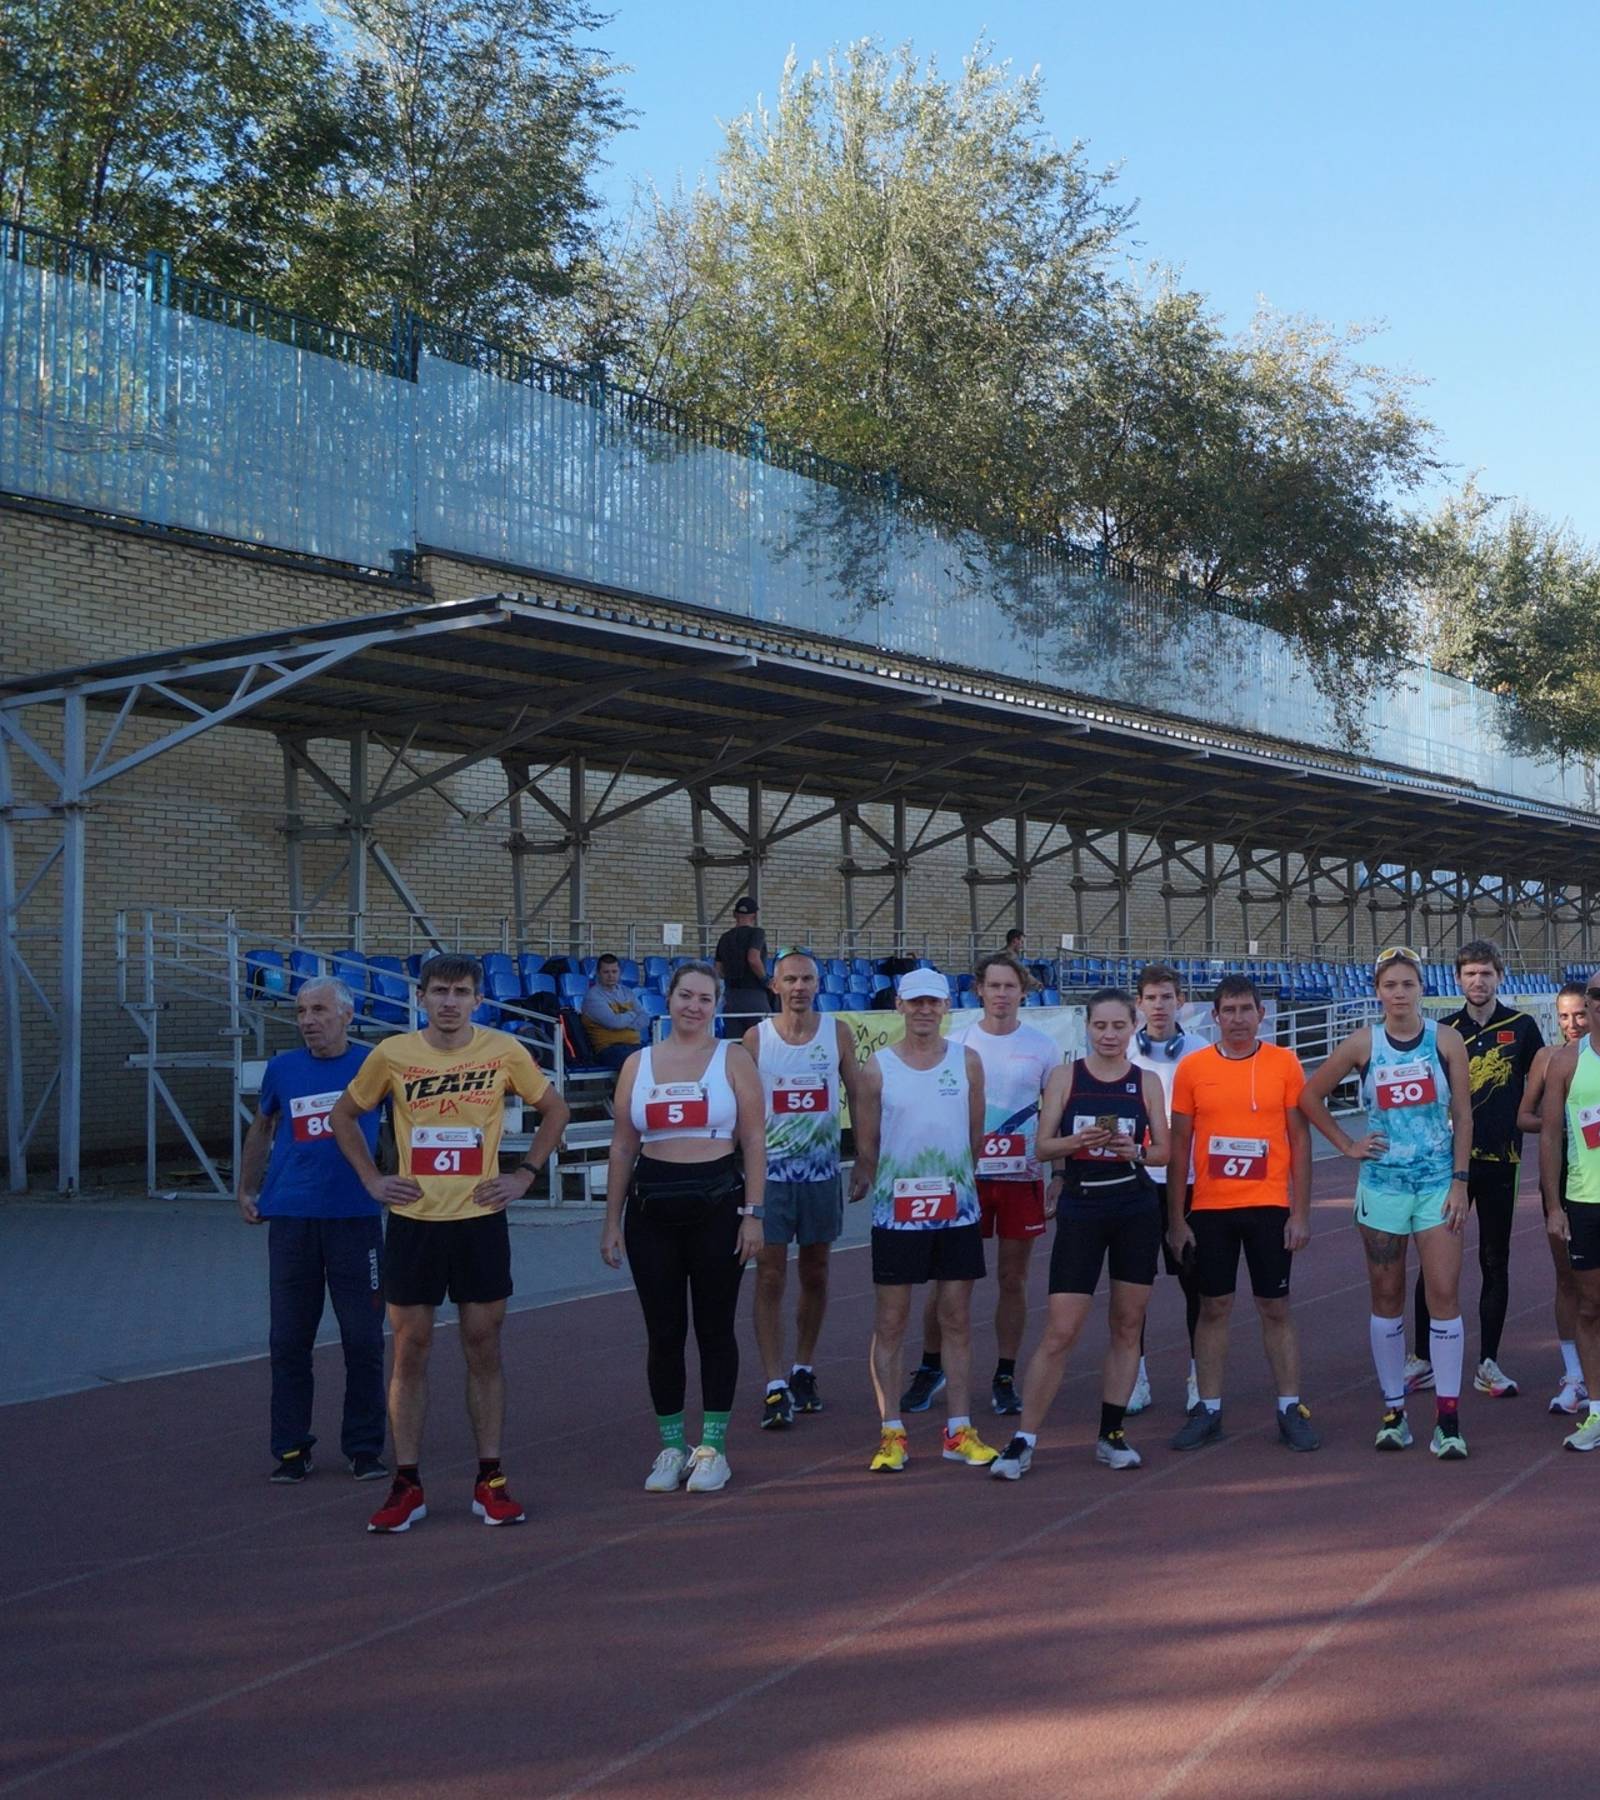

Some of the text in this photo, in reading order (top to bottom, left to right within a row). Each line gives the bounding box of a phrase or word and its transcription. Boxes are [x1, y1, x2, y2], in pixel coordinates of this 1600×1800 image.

[404, 1069, 498, 1103] YEAH!
[1389, 1083, 1423, 1104] 30
[787, 1092, 816, 1110] 56
[667, 1104, 684, 1124] 5
[984, 1138, 1012, 1156] 69
[434, 1150, 460, 1172] 61
[1223, 1158, 1253, 1177] 67
[911, 1198, 941, 1218] 27
